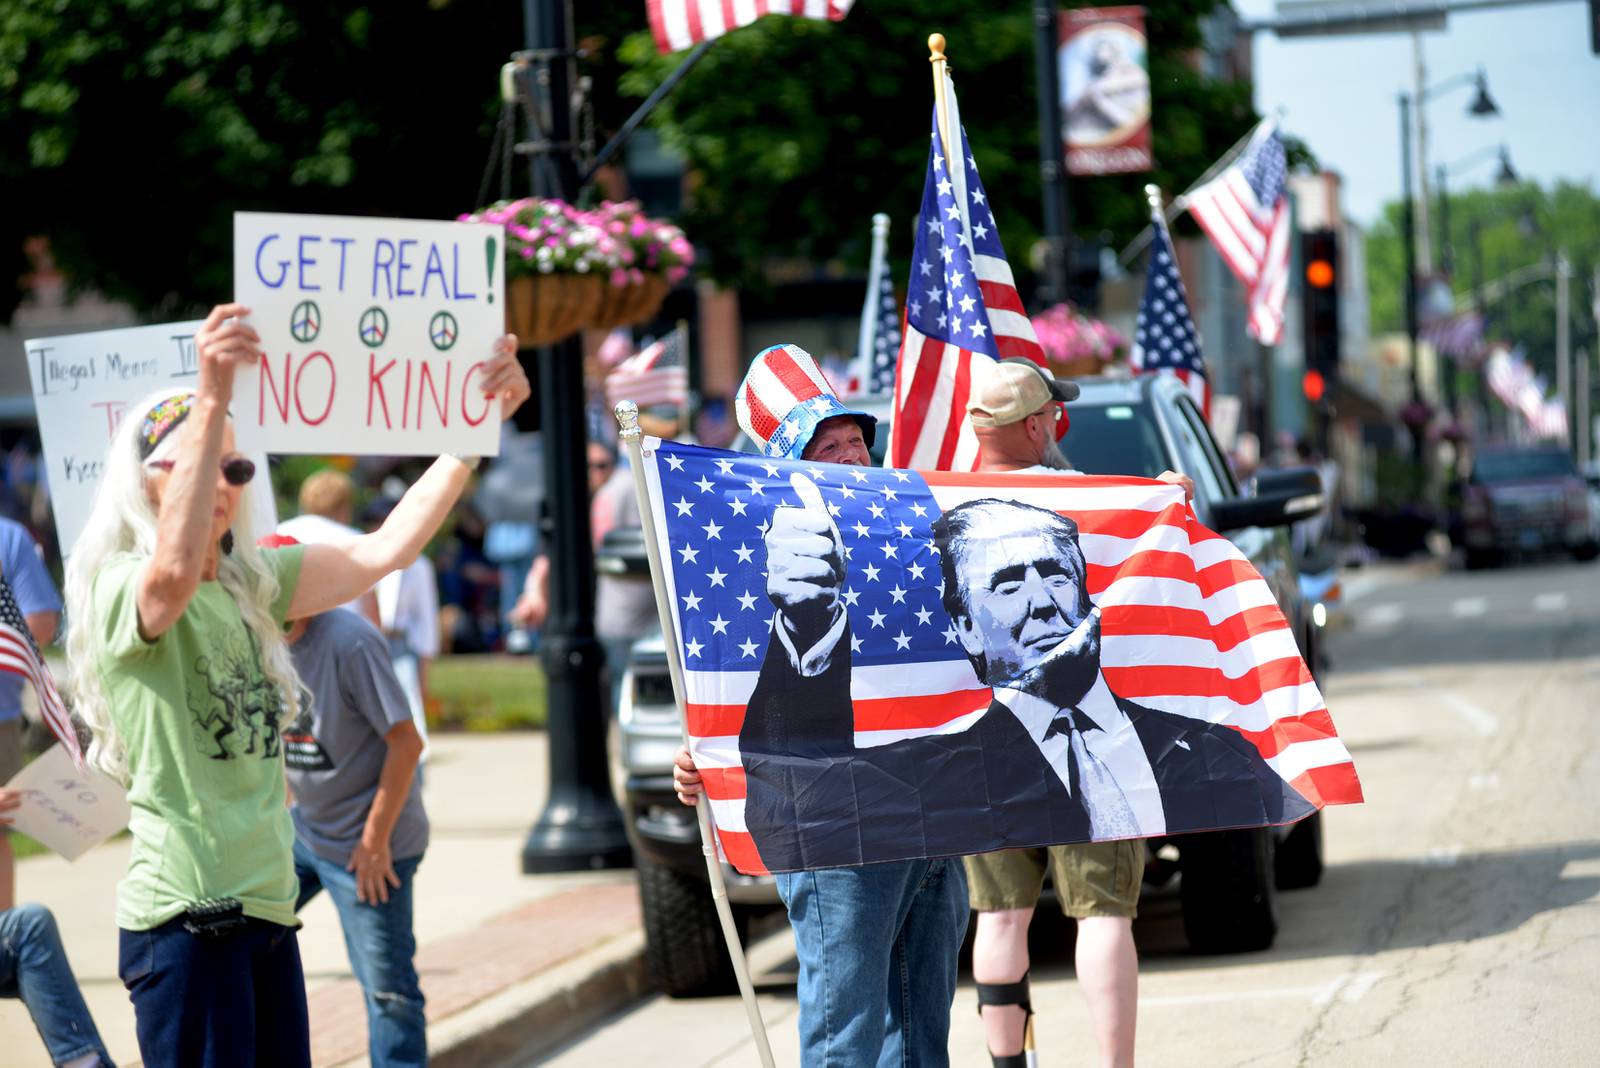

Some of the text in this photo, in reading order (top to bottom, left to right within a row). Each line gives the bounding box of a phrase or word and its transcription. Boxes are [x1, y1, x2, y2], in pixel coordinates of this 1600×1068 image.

[255, 234, 497, 304] GET REAL!
[29, 347, 96, 395] Illegal
[258, 351, 336, 427] NO
